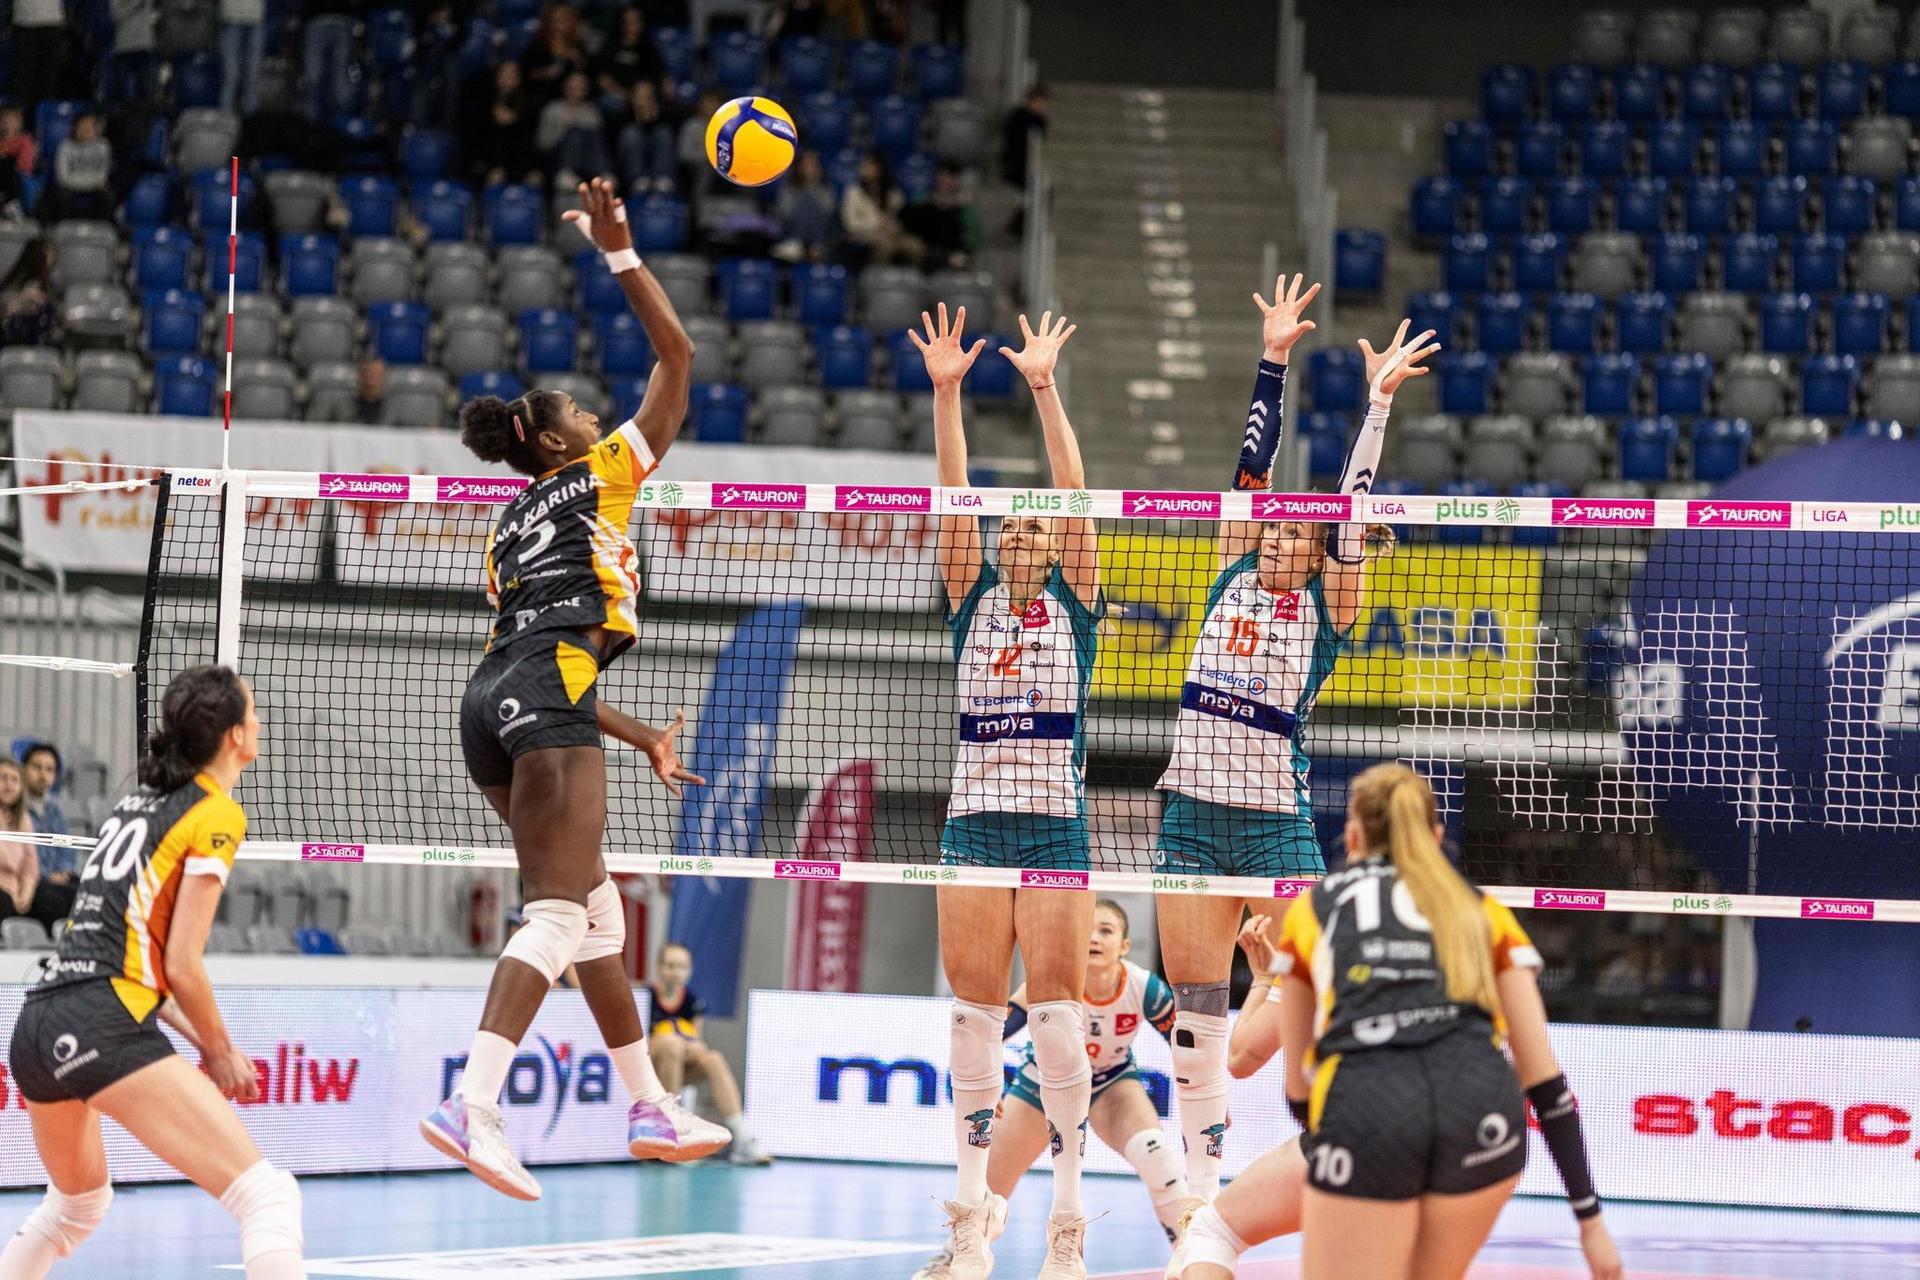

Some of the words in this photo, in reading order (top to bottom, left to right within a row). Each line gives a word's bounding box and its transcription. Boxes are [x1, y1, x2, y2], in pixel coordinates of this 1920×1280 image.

[177, 476, 211, 487] netex
[348, 480, 402, 493] TAURON
[468, 484, 521, 496] TAURON
[742, 490, 797, 503] TAURON
[522, 474, 607, 529] KARINA
[865, 493, 922, 506] TAURON
[1012, 490, 1061, 513] plus
[1154, 499, 1212, 512] TAURON
[1283, 501, 1342, 514] TAURON
[1436, 499, 1488, 521] plus
[1584, 506, 1646, 520] TAURON
[1720, 508, 1782, 522] TAURON
[1880, 505, 1920, 529] plu
[1225, 616, 1261, 657] 15
[992, 643, 1022, 677] 12
[1199, 690, 1255, 719] moya
[977, 714, 1034, 737] moya
[80, 816, 148, 881] 20
[321, 848, 360, 858] TAURON
[422, 848, 456, 864] plus
[659, 857, 693, 872] plus
[795, 864, 835, 877] TAURON
[902, 866, 937, 882] plus
[1041, 874, 1083, 886] TAURON
[1152, 876, 1188, 892] plus
[1556, 894, 1599, 905] TAURON
[1672, 896, 1710, 912] plus
[1824, 904, 1868, 915] TAURON
[199, 1041, 360, 1105] aliw
[1633, 1088, 1920, 1160] stac
[1312, 1143, 1353, 1187] 10
